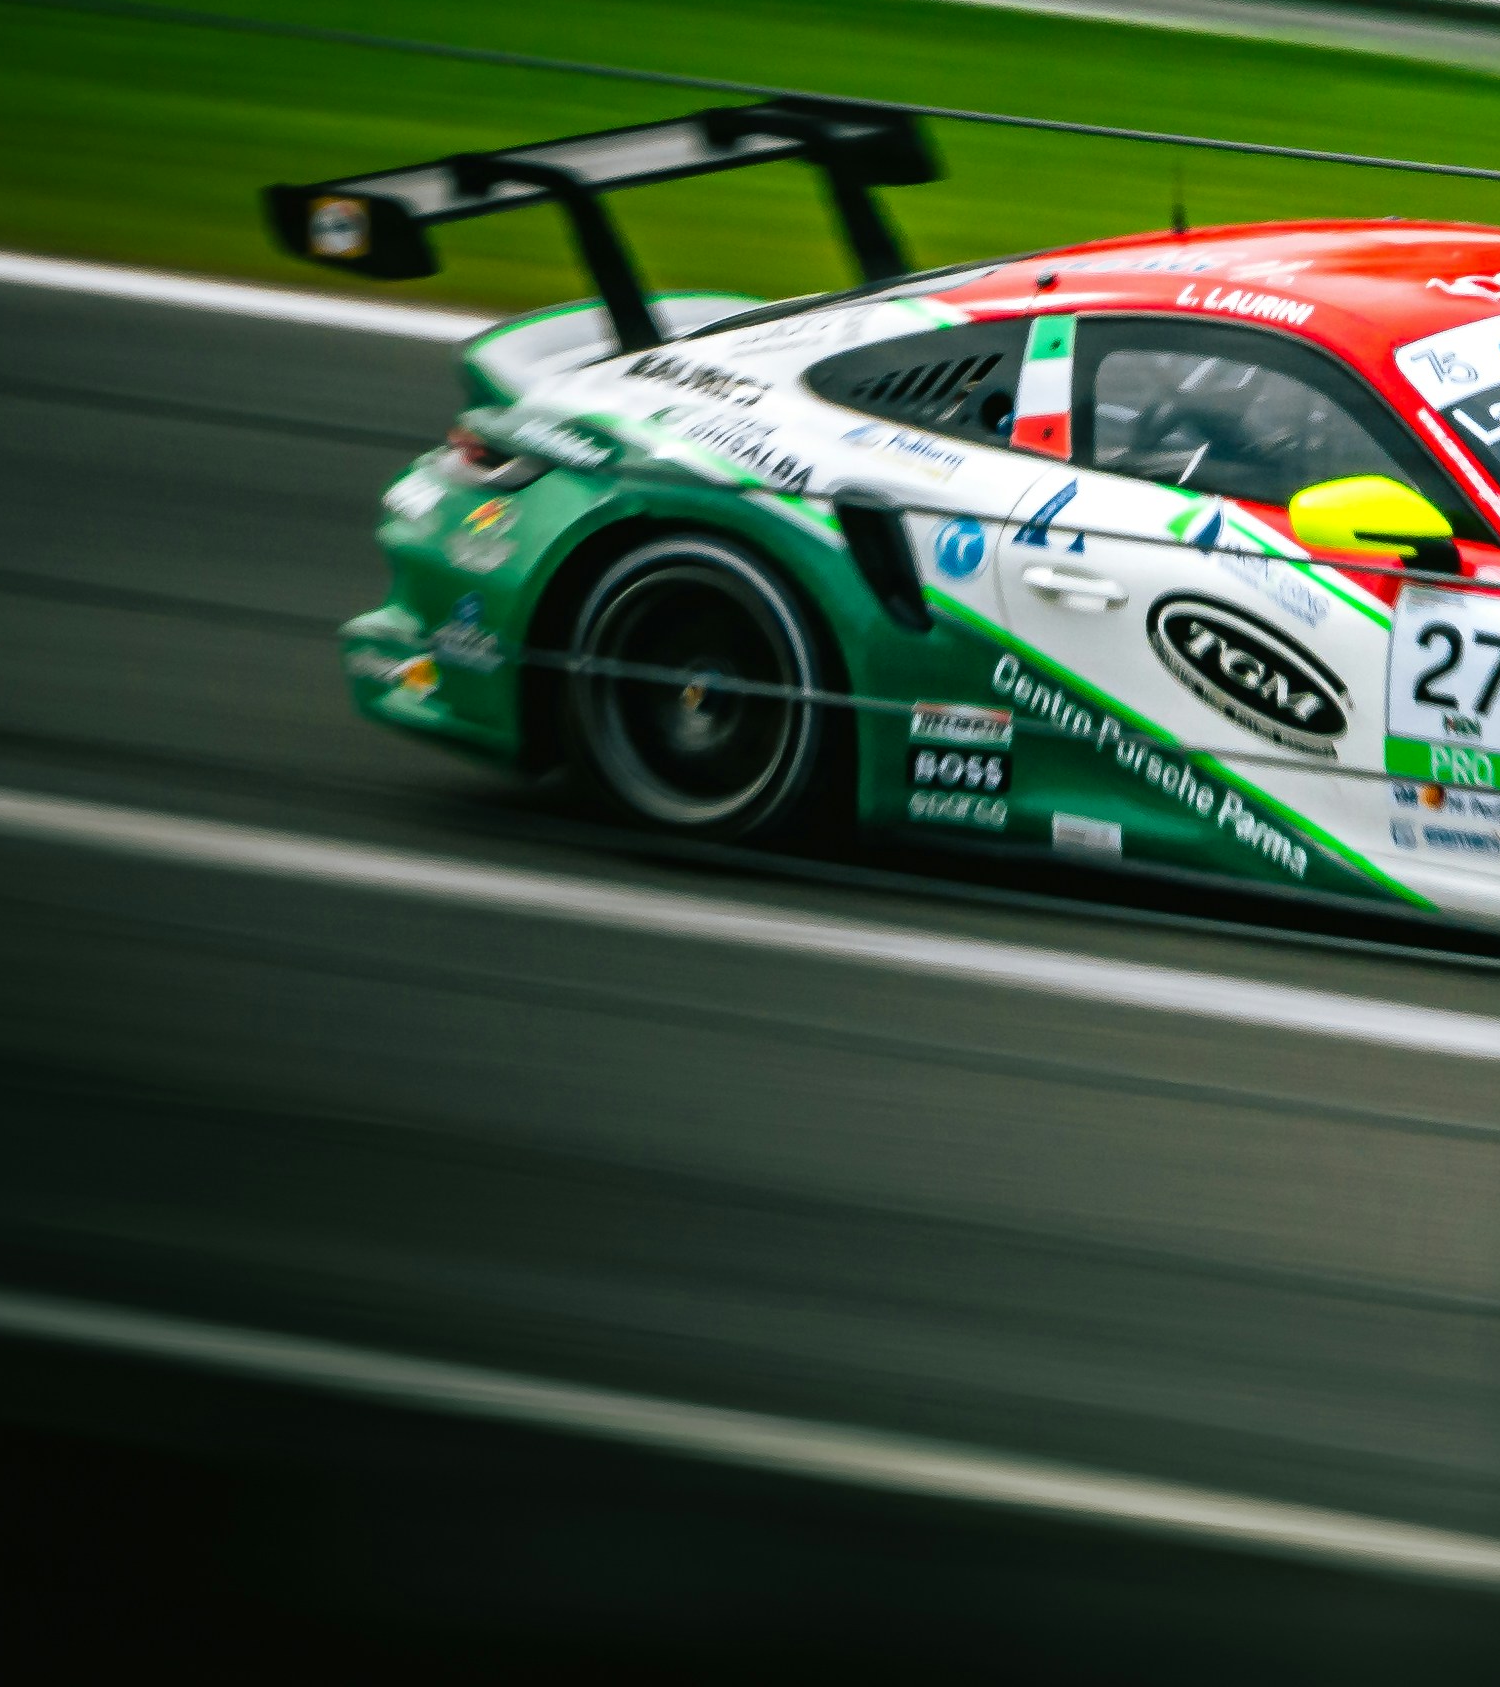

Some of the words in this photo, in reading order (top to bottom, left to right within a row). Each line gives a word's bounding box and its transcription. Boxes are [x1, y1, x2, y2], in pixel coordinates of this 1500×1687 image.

[1176, 282, 1200, 308] L.
[1203, 286, 1316, 326] LAURINI
[1183, 620, 1325, 723] TGM
[913, 748, 1004, 792] BOSS
[1429, 744, 1494, 787] PRO
